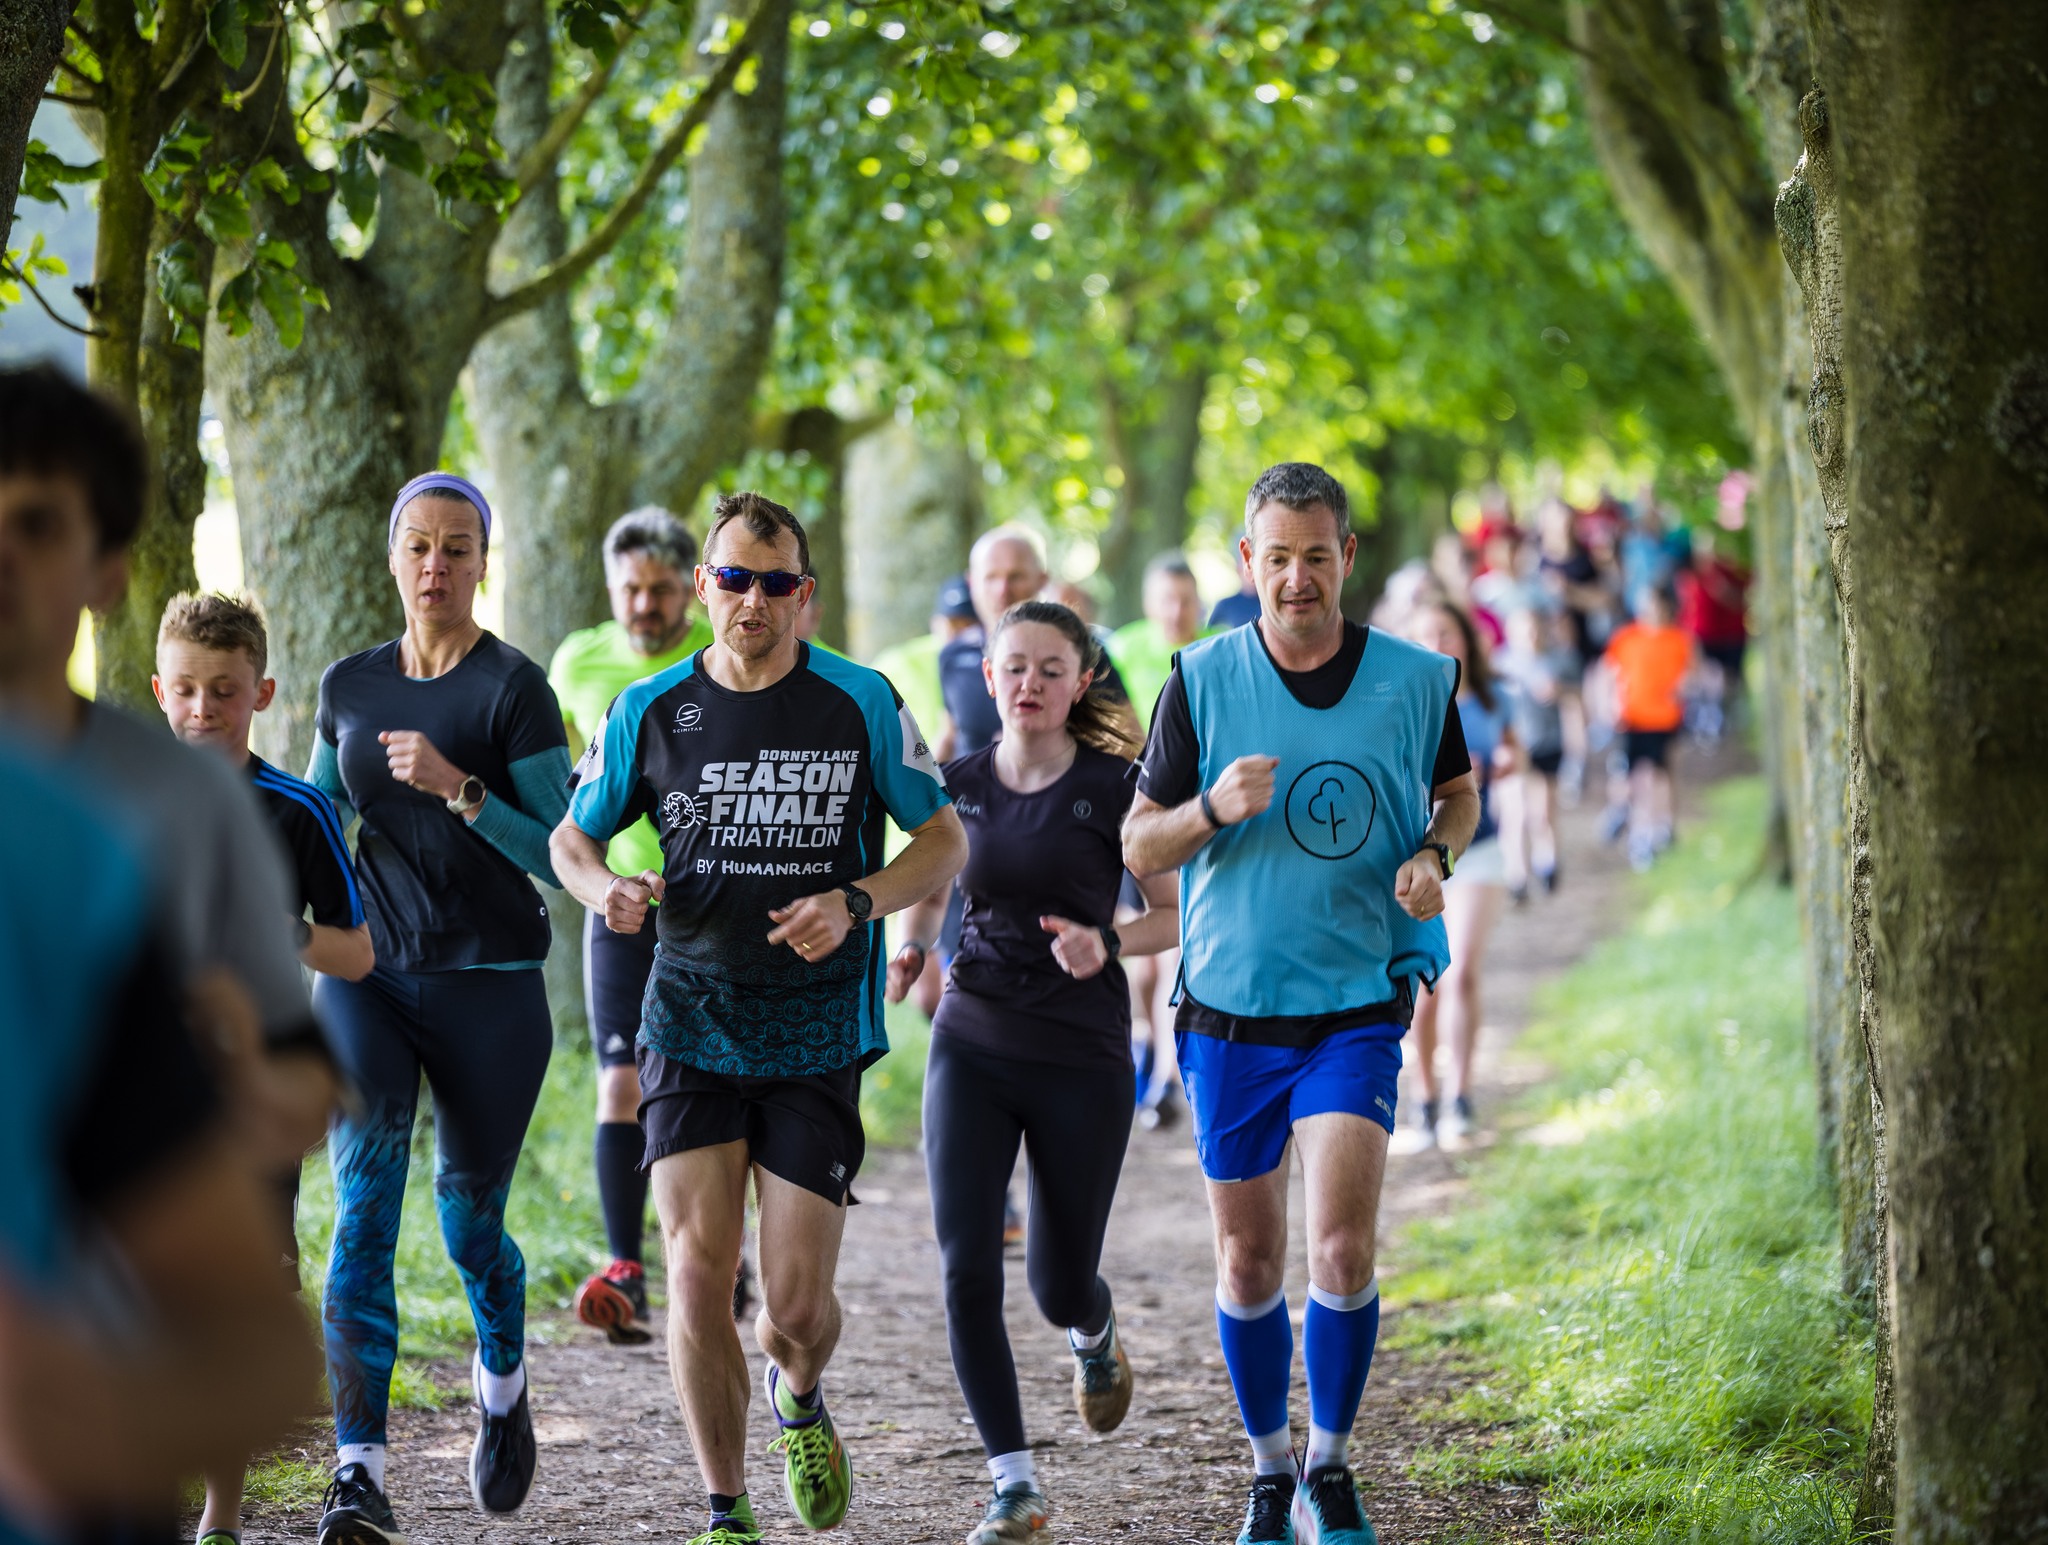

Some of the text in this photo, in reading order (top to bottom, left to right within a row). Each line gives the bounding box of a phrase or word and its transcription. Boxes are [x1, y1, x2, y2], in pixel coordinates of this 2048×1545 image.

[672, 726, 703, 734] SCIMITAR
[758, 749, 860, 762] DORNEY LAKE
[698, 762, 858, 793] SEASON
[709, 794, 850, 825] FINALE
[707, 826, 842, 848] TRIATHLON
[696, 859, 833, 877] BY HUMANRACE
